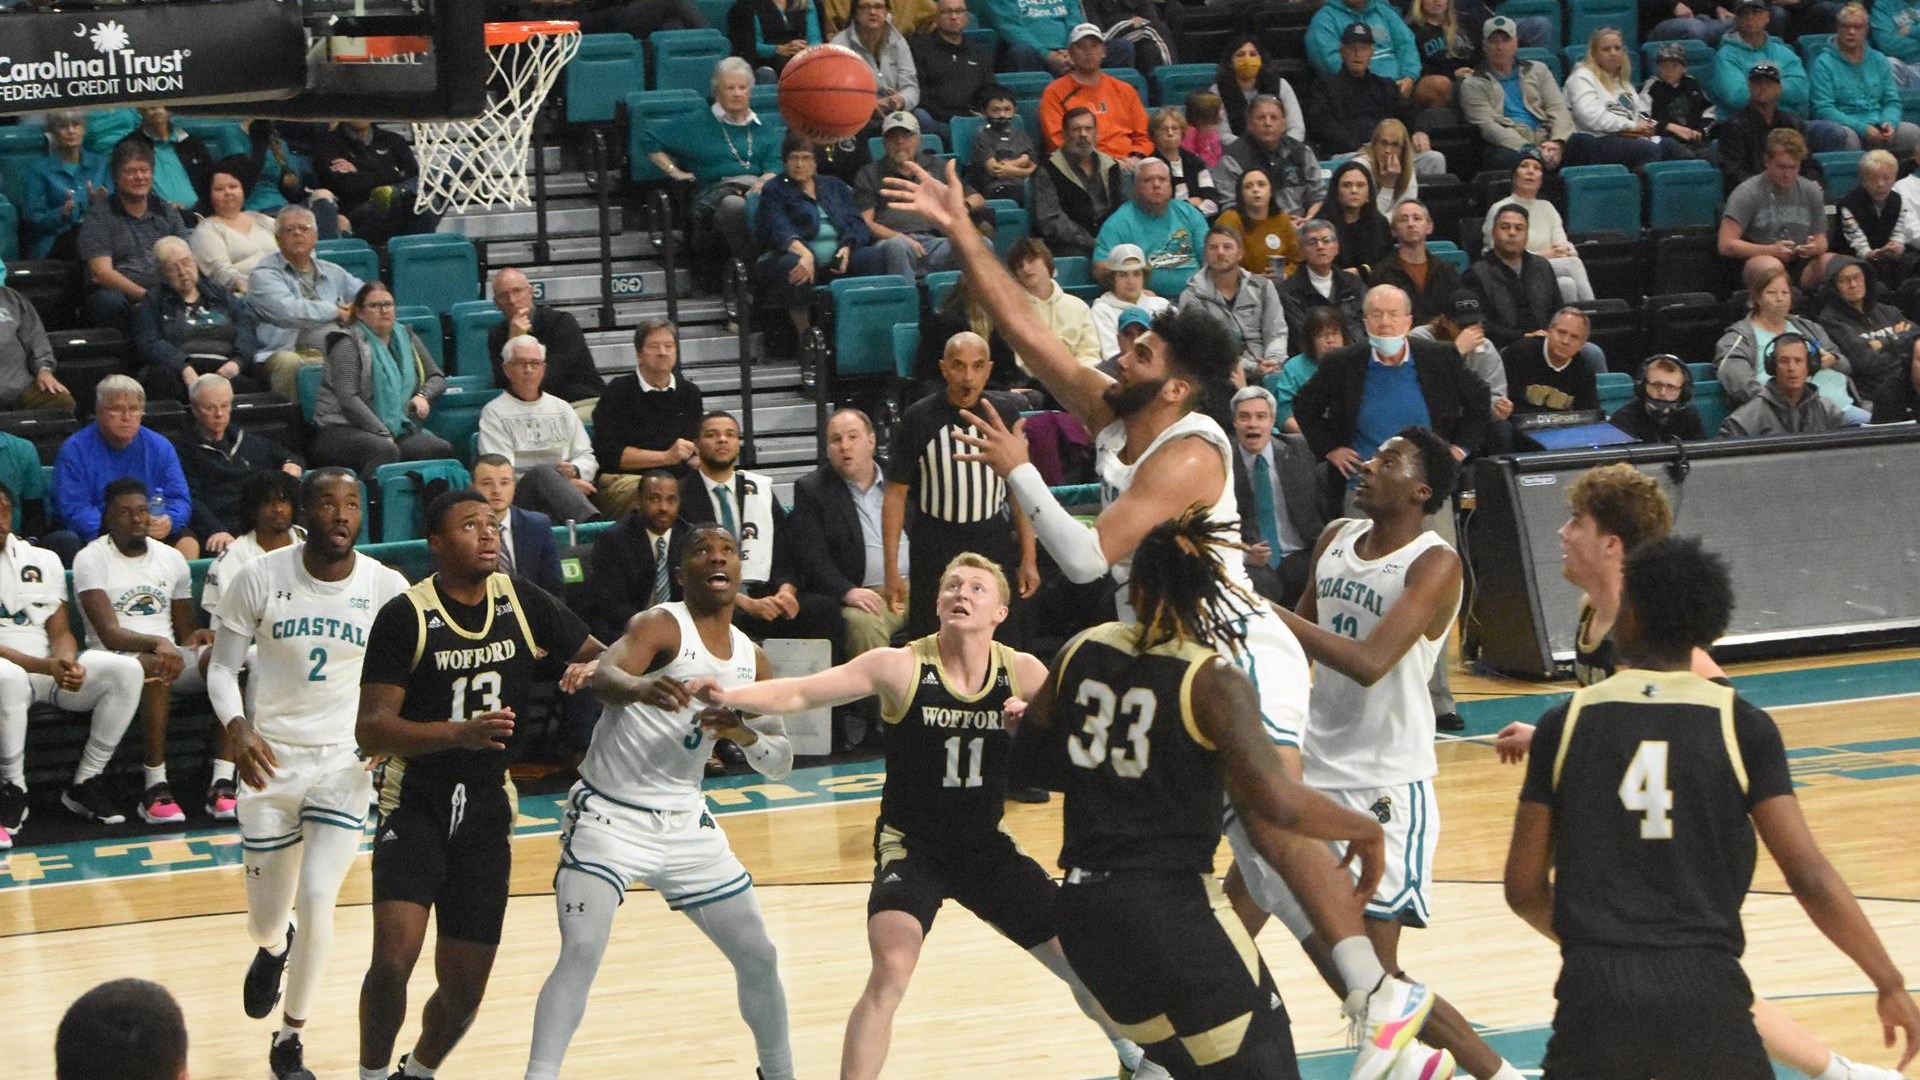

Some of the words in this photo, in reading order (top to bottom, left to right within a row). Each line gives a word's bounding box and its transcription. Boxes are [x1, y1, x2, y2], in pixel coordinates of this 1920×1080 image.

[0, 51, 105, 83] Carolina
[67, 79, 120, 97] CREDIT
[126, 75, 183, 93] UNION
[272, 617, 366, 648] COASTAL
[307, 647, 328, 682] 2
[434, 638, 517, 671] WOFFORD
[448, 670, 503, 723] 13
[921, 706, 1006, 730] WOFFOR
[1067, 678, 1157, 778] 33
[942, 735, 985, 788] 11
[1618, 740, 1674, 840] 4
